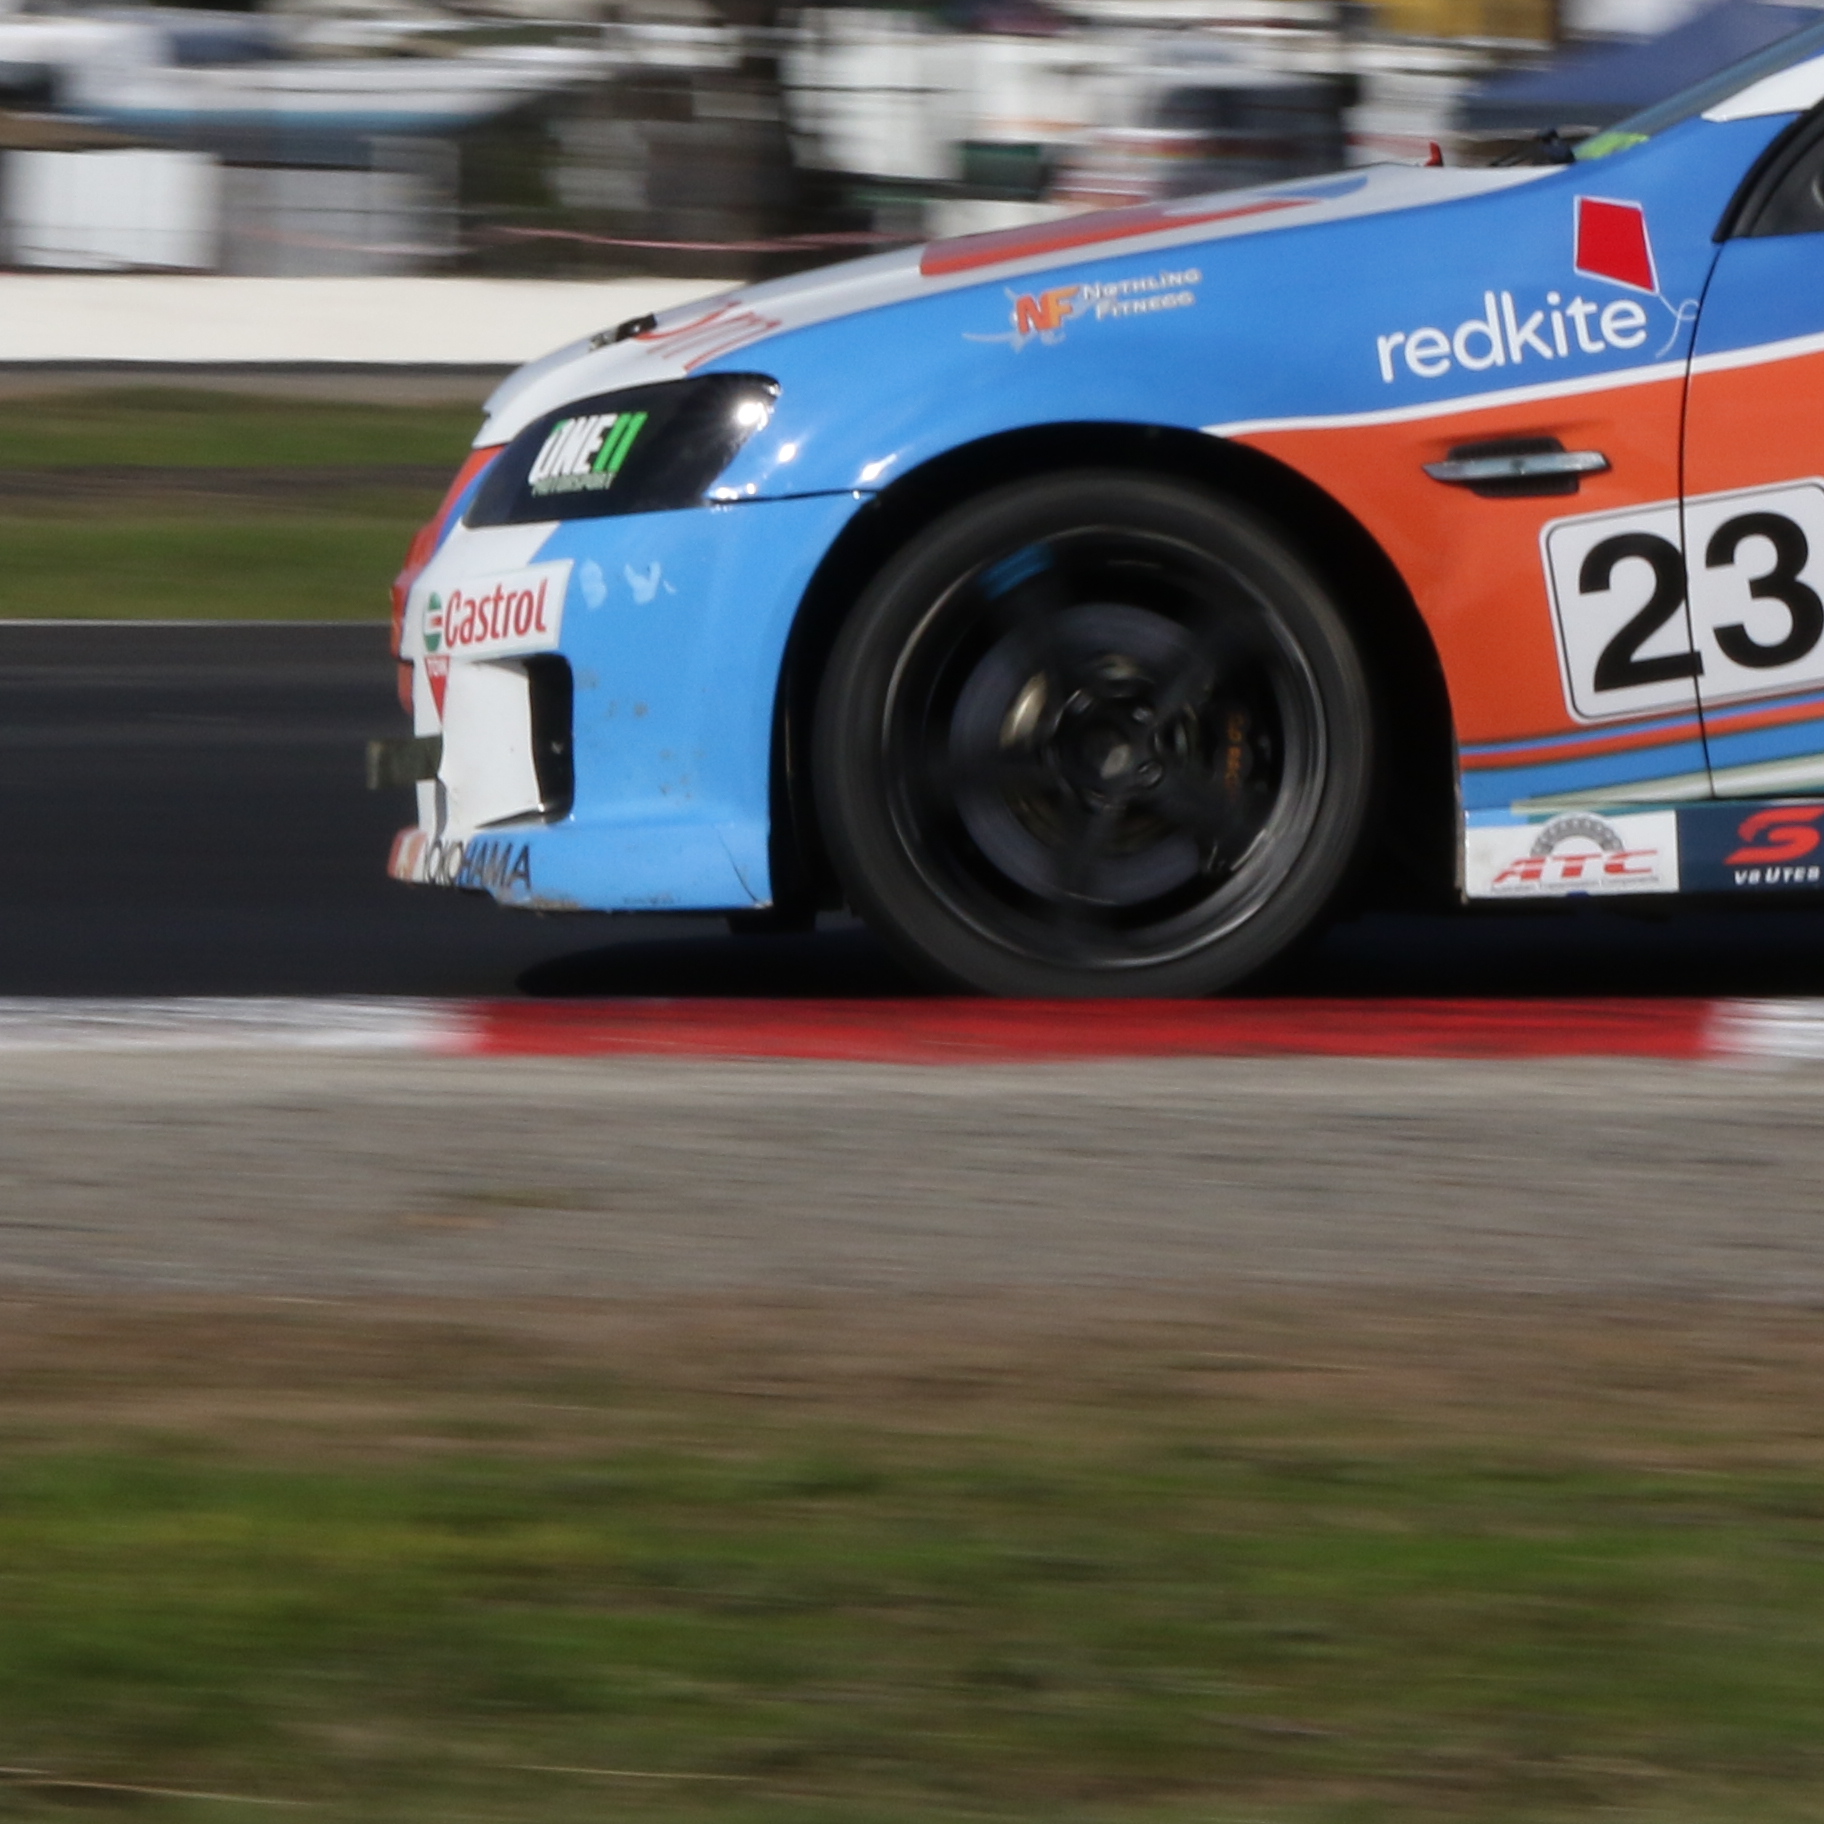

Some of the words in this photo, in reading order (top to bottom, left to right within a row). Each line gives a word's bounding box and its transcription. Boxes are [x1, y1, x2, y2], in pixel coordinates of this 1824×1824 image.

[1015, 284, 1080, 335] NF
[1376, 290, 1648, 383] redkite
[444, 576, 549, 649] Castrol
[1492, 848, 1659, 884] ATC
